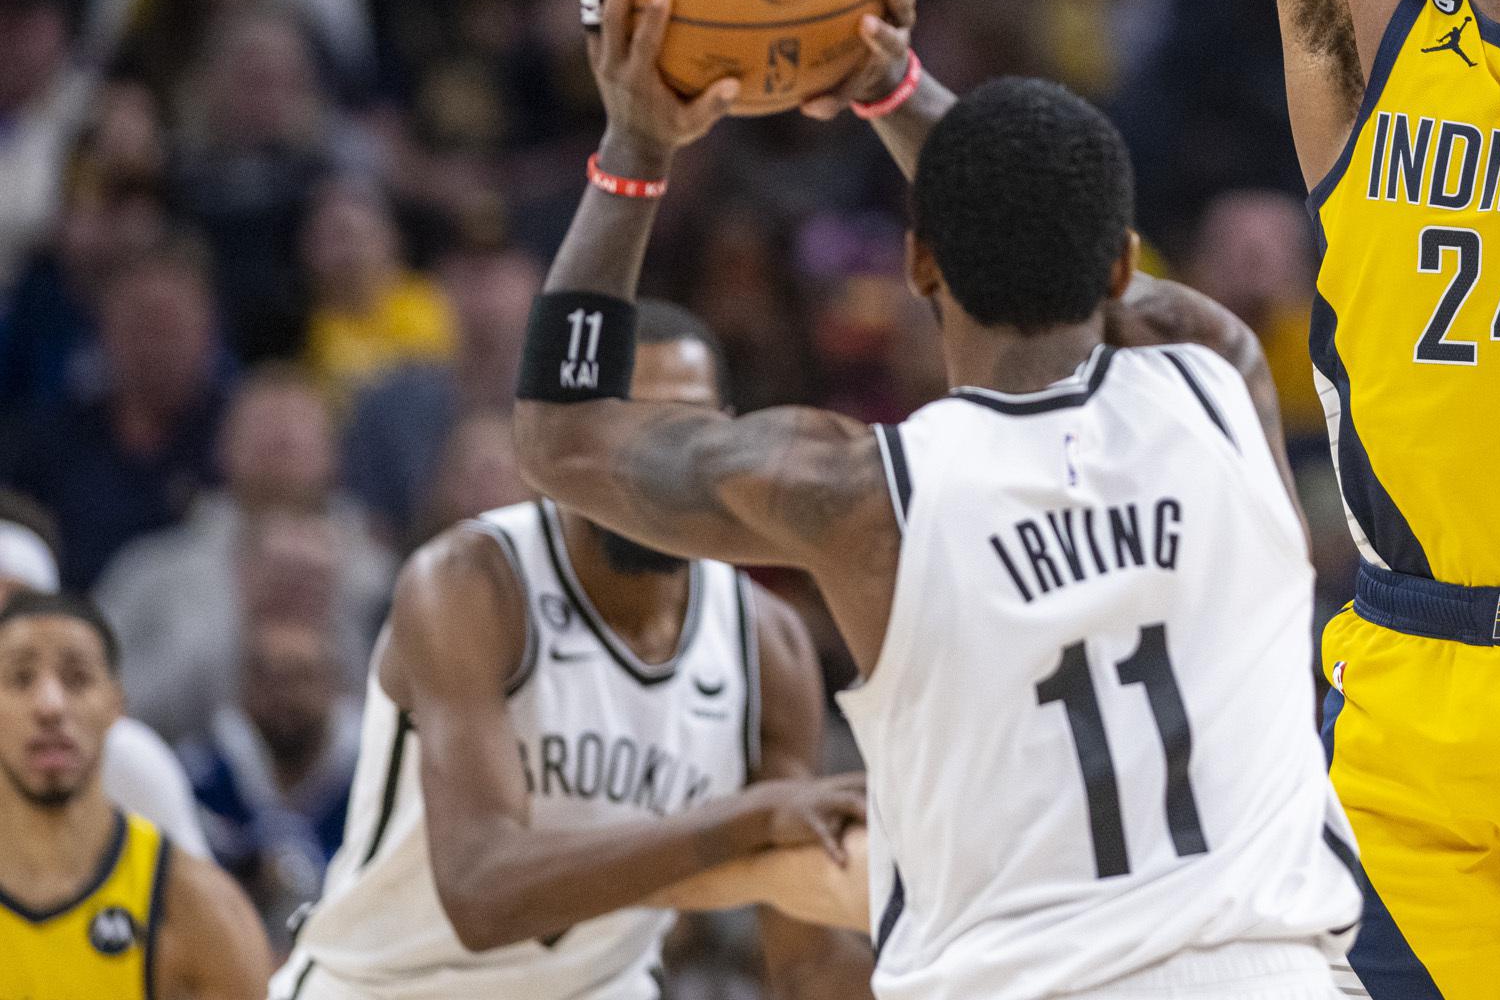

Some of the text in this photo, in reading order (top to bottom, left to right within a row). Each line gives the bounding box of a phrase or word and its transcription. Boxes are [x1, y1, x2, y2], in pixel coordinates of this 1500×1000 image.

[560, 359, 600, 389] KAI
[568, 308, 603, 361] 11
[989, 498, 1185, 603] IRVING
[1034, 621, 1210, 879] 11
